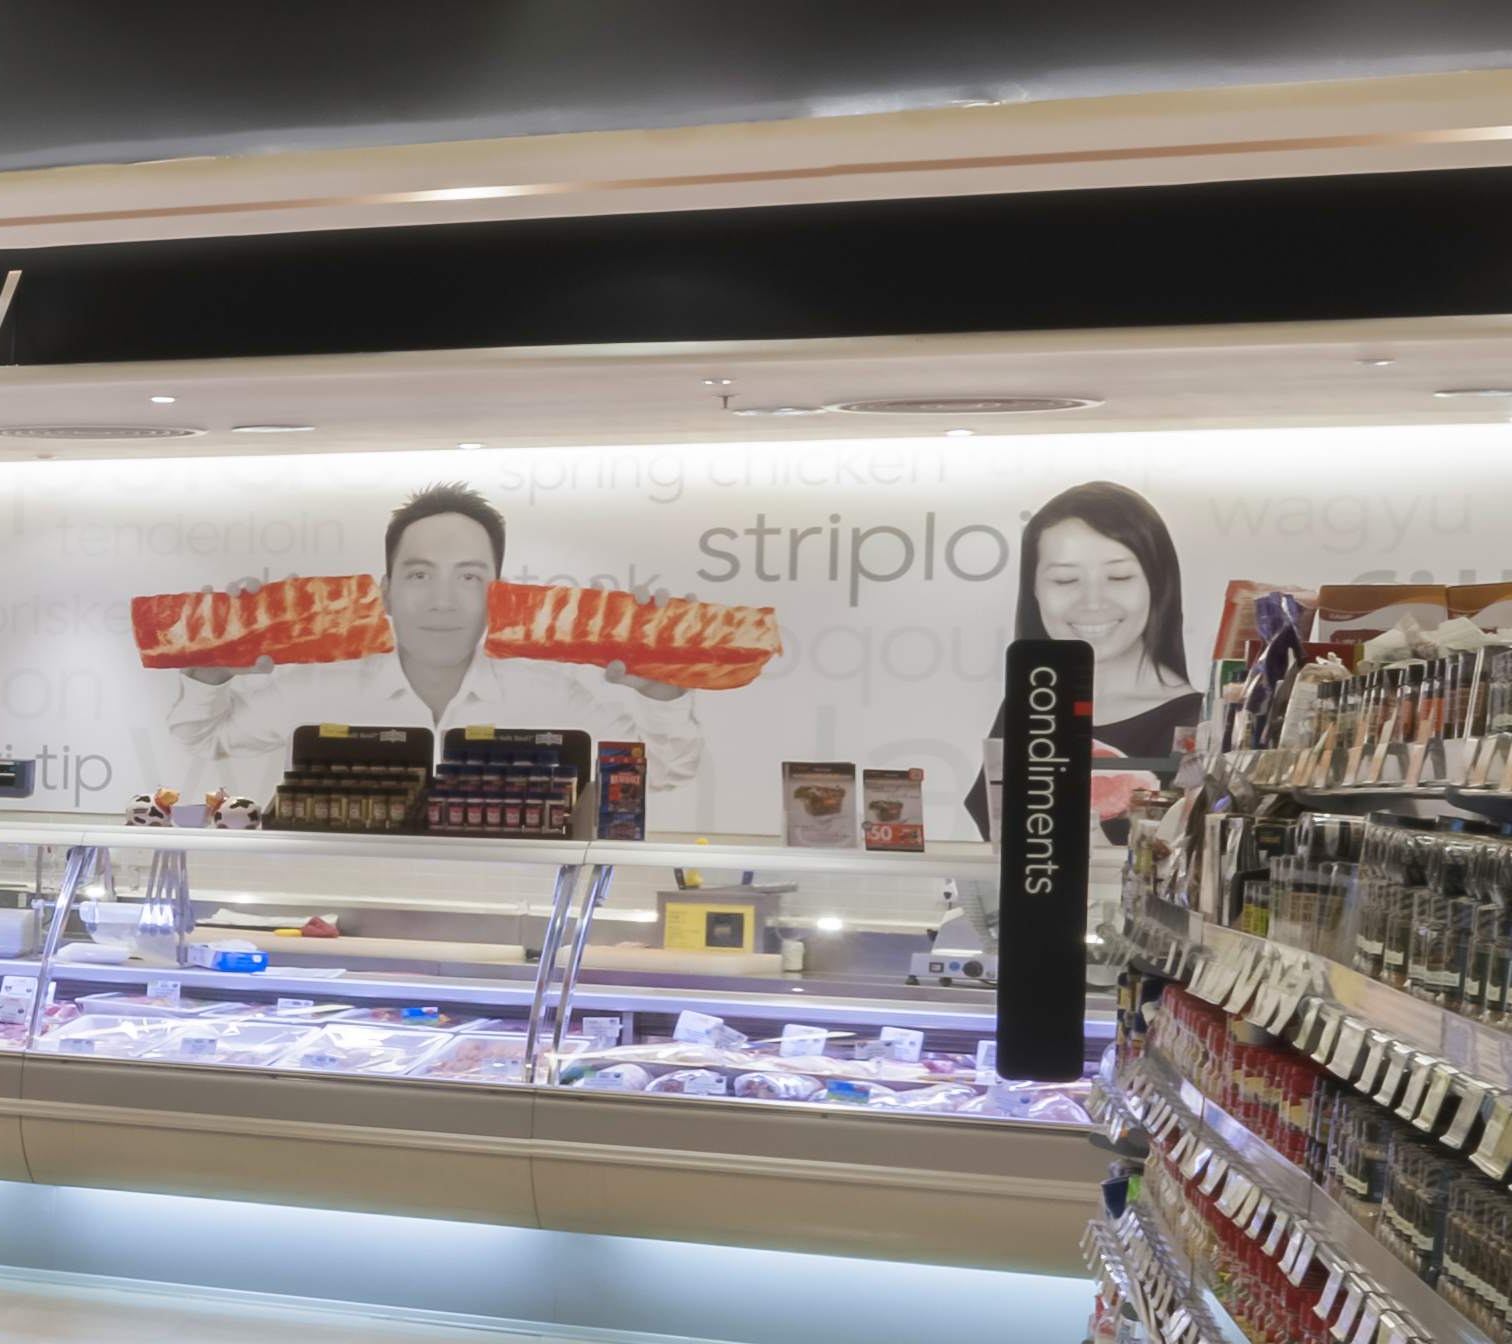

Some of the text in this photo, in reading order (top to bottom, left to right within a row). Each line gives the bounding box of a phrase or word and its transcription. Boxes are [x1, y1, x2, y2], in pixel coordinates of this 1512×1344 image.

[61, 510, 346, 559] tenderloin
[1209, 492, 1473, 556] wagyu
[696, 509, 1035, 608] striplo
[40, 744, 114, 807] tip
[1025, 666, 1070, 895] condiments
